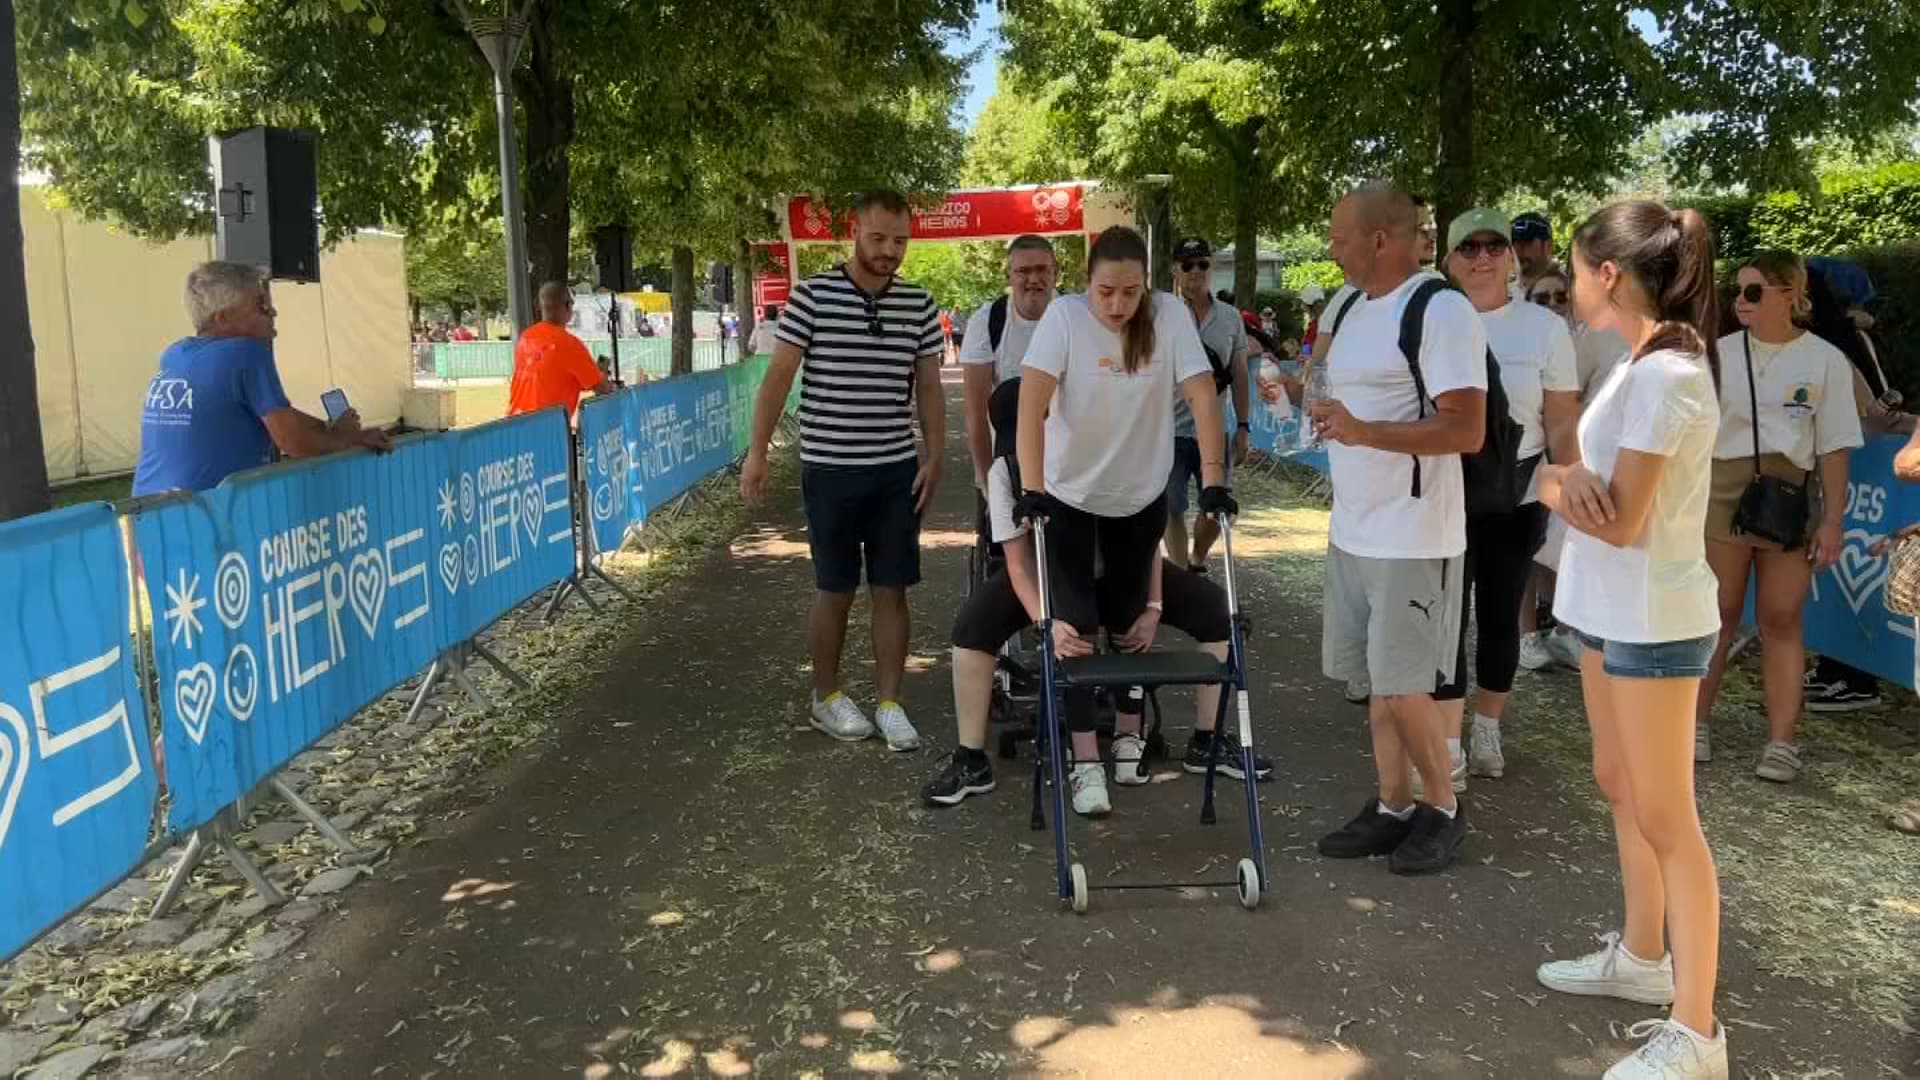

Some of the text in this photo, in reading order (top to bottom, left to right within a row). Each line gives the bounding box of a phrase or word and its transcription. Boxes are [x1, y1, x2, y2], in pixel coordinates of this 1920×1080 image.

[478, 452, 534, 497] COURSE DES
[260, 505, 368, 583] COURSE DES
